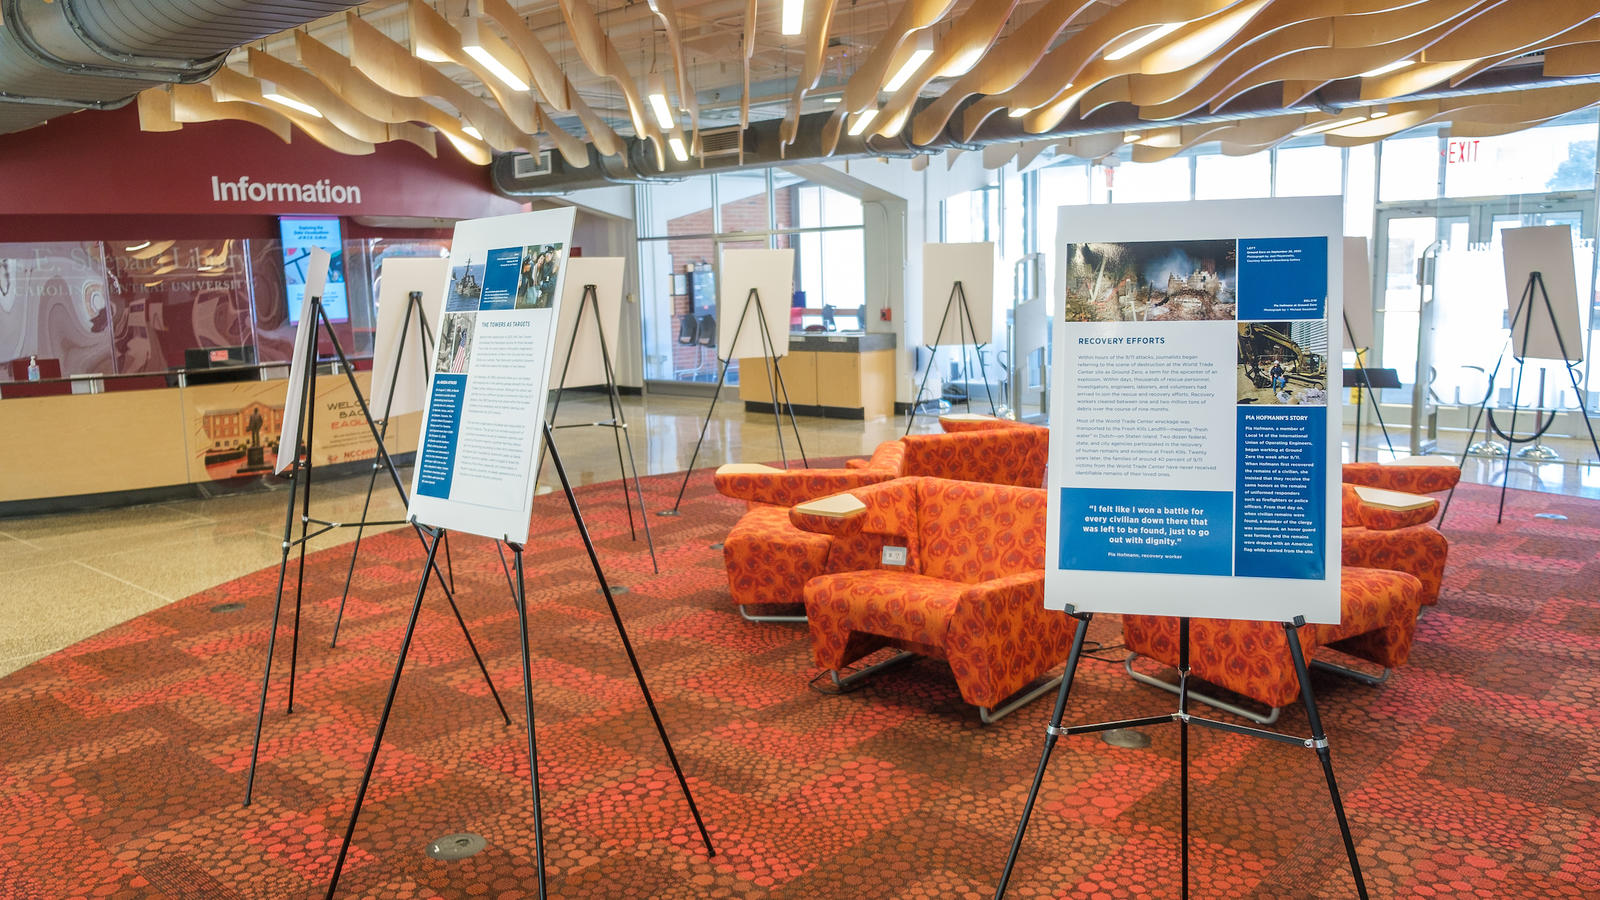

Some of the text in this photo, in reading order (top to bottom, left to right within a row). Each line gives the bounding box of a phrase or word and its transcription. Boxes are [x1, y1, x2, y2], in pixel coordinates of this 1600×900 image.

[1449, 140, 1480, 163] EXIT
[212, 176, 361, 204] Information
[331, 418, 368, 430] EAGL
[1140, 527, 1167, 535] found,
